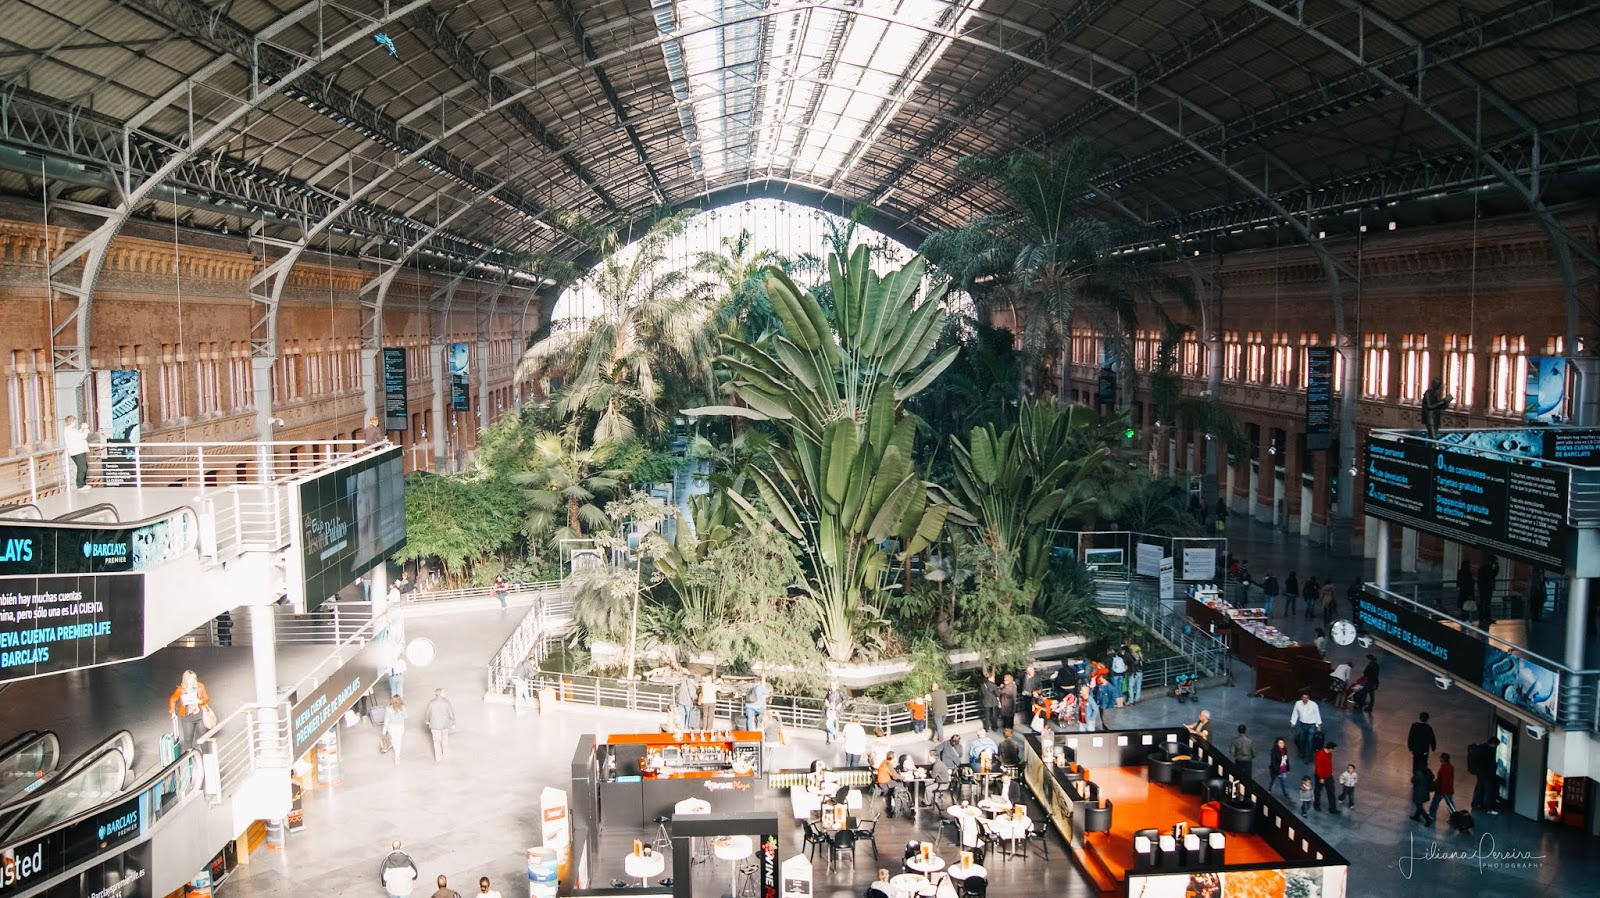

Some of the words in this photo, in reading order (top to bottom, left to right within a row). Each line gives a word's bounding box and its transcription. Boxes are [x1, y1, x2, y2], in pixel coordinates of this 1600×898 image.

[1448, 464, 1454, 472] de
[1456, 467, 1486, 480] comisiones
[1437, 476, 1458, 488] Tarjetas
[1459, 482, 1483, 494] gratuitas
[1436, 494, 1466, 509] Disposición
[1466, 503, 1489, 516] gratuita
[1443, 506, 1464, 518] efectivo
[325, 516, 347, 546] Público
[93, 543, 126, 556] BARCLAYS
[18, 593, 31, 607] hay
[32, 591, 57, 603] muchas
[58, 591, 82, 600] cuentas
[17, 610, 32, 623] pero
[33, 606, 47, 618] sólo
[48, 608, 60, 617] una
[61, 607, 69, 616] es
[70, 604, 78, 615] LA
[79, 602, 103, 614] CUENTA
[1360, 600, 1376, 612] NUEVA
[1377, 608, 1398, 622] CUENTA
[21, 628, 56, 645] CUENTA
[57, 623, 93, 640] PREMIER
[94, 621, 111, 636] LIFE
[1360, 610, 1386, 632] PREMIER
[1387, 623, 1401, 638] LIFE
[1402, 630, 1411, 643] DE
[1413, 635, 1448, 660] BARCLAYS
[1, 647, 49, 668] BARCLAYS
[296, 715, 320, 746] PREMIER
[320, 704, 331, 724] LIFE
[331, 697, 338, 713] DE
[338, 677, 360, 706] BARCLAYS
[296, 709, 310, 730] NUEVA
[311, 694, 327, 715] CUENTA
[106, 810, 137, 836] BARCLAYS
[118, 824, 137, 837] PREMIER
[765, 851, 774, 886] WINE
